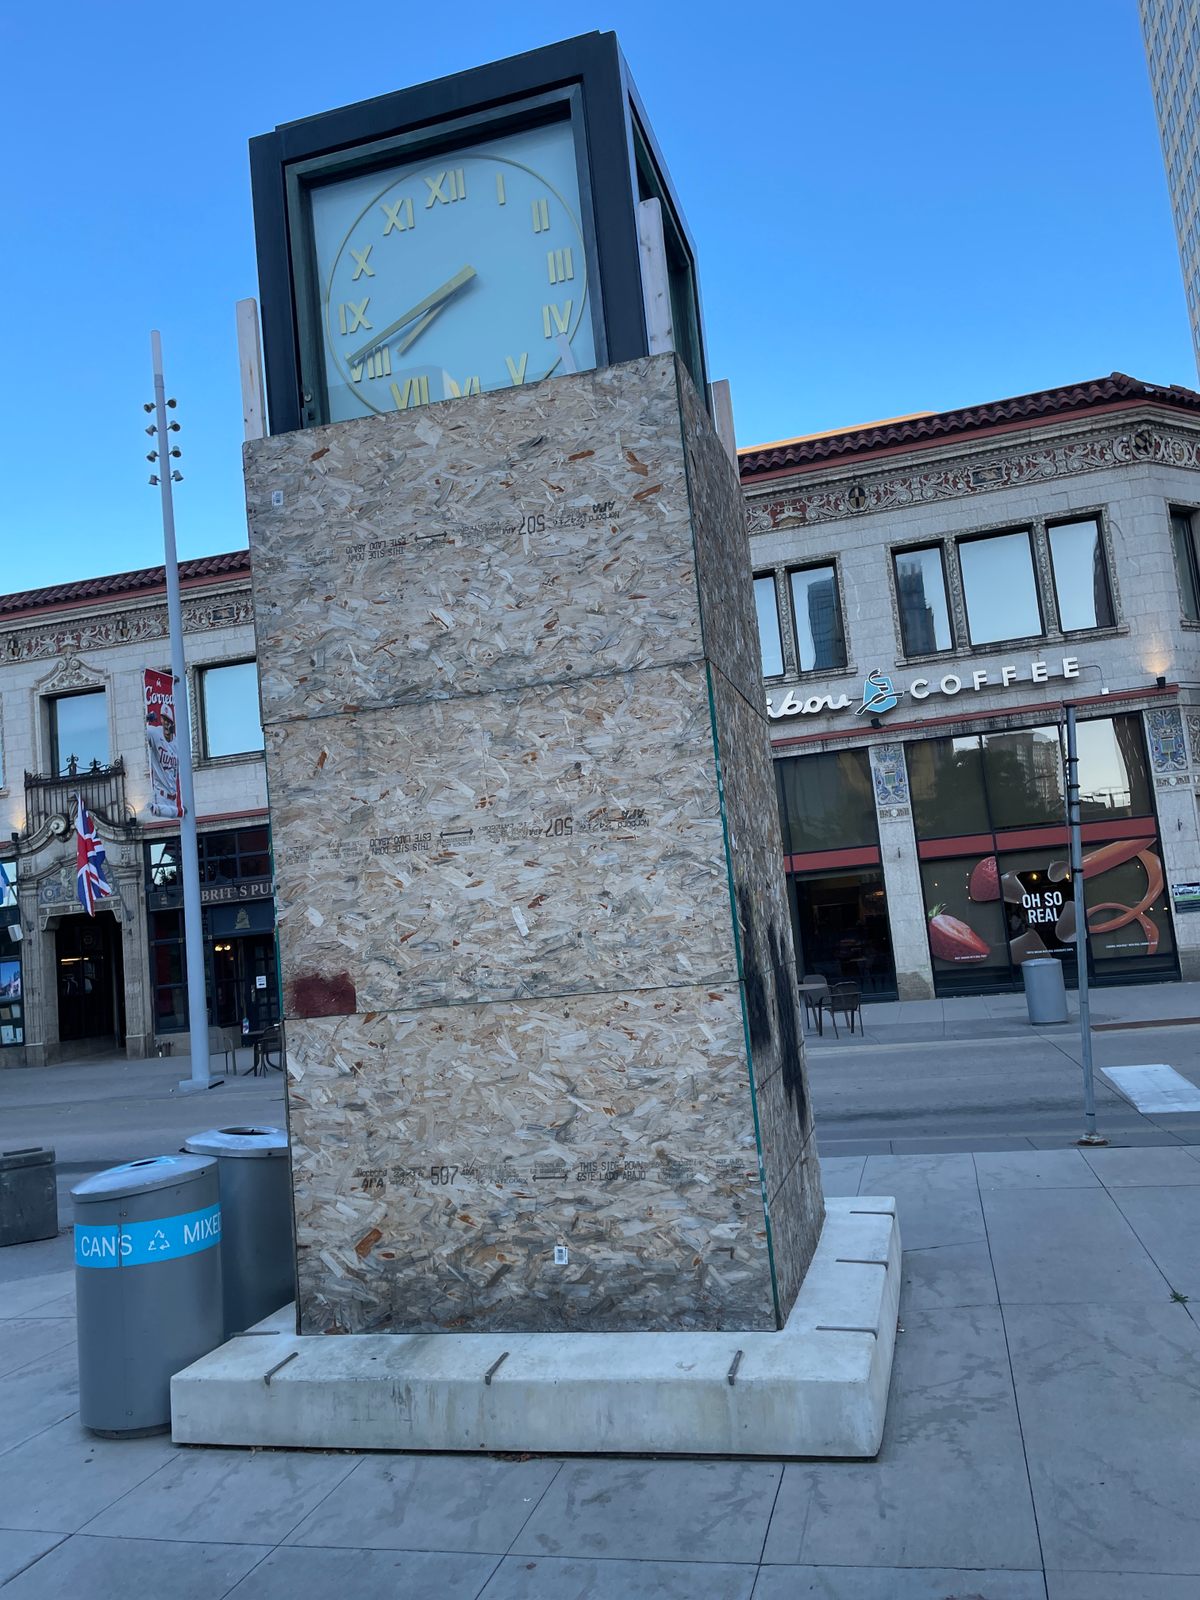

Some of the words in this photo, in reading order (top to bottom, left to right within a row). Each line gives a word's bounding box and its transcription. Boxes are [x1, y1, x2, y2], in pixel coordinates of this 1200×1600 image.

[424, 168, 466, 208] XII
[496, 172, 506, 205] I
[380, 198, 415, 236] XI
[531, 198, 550, 233] II
[350, 245, 375, 281] X
[547, 247, 575, 284] III
[339, 297, 373, 335] IX
[542, 300, 573, 339] IV
[505, 352, 528, 385] V
[390, 375, 431, 410] VII
[591, 501, 616, 513] APA
[518, 514, 545, 535] 507
[369, 540, 386, 551] LADO
[388, 546, 404, 555] THIS
[389, 536, 406, 547] ESTE
[368, 550, 385, 560] SIDE
[766, 690, 853, 719] ibou
[910, 656, 1080, 699] COFFEE
[158, 746, 178, 767] Twin
[414, 832, 432, 843] ESTE
[545, 817, 573, 838] 507
[393, 835, 411, 845] LADO
[412, 841, 429, 851] THIS
[1022, 893, 1041, 909] OH
[1044, 891, 1063, 907] SO
[1028, 908, 1060, 924] REAL
[431, 1166, 459, 1186] 507
[577, 1172, 597, 1182] ESTE
[600, 1171, 619, 1182] LADO
[579, 1161, 598, 1171] THIS
[81, 1234, 133, 1257] CANS
